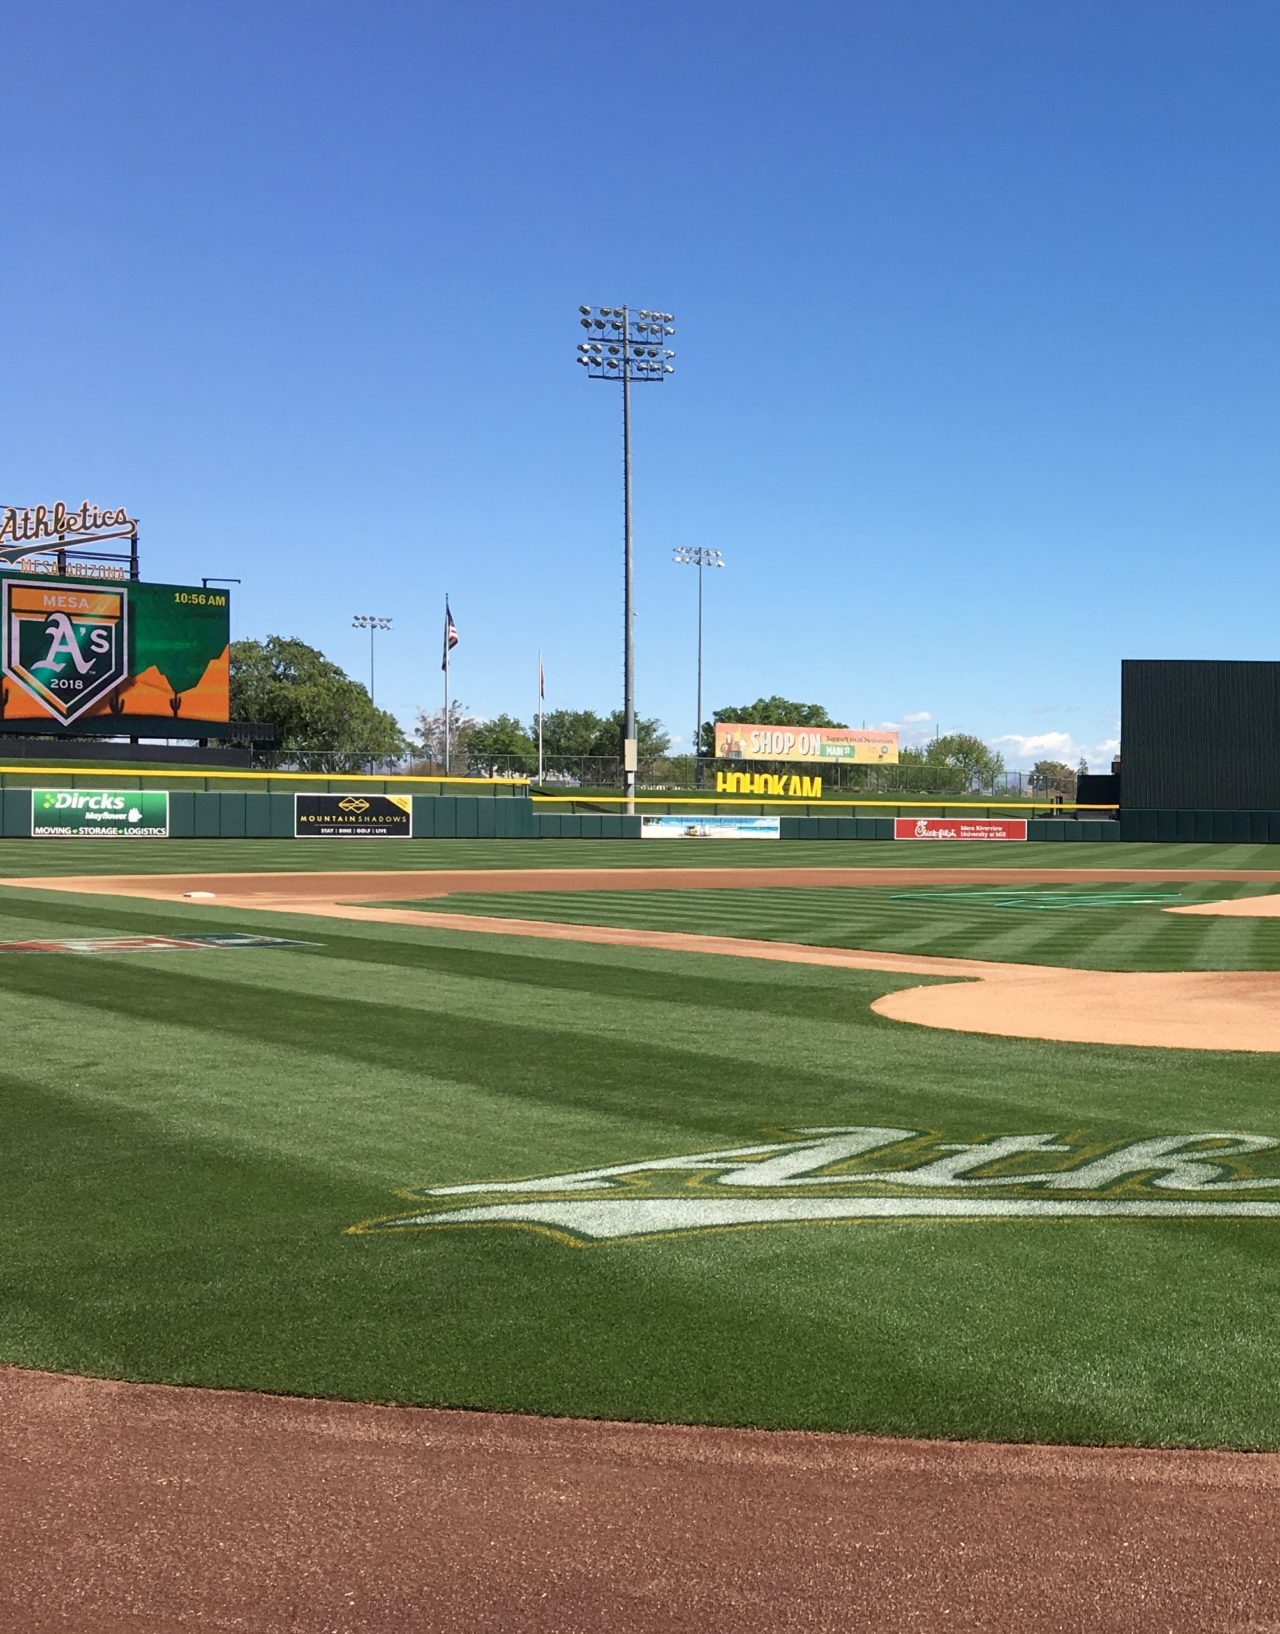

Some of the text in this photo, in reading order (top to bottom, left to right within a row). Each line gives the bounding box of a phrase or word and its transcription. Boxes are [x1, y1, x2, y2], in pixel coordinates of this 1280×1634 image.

[0, 499, 135, 545] Athletics
[21, 558, 125, 580] MESA ARIZONA
[43, 595, 89, 609] MESA
[174, 592, 226, 606] 10:56 AM
[51, 679, 84, 690] 2018
[750, 730, 821, 756] SHOP ON
[826, 746, 844, 756] MAIN
[716, 771, 822, 798] HOHOKAM
[55, 793, 125, 809] Dircks
[85, 811, 127, 821] Mayflower
[35, 827, 166, 835] MOVING STORAGE LOGISTICS
